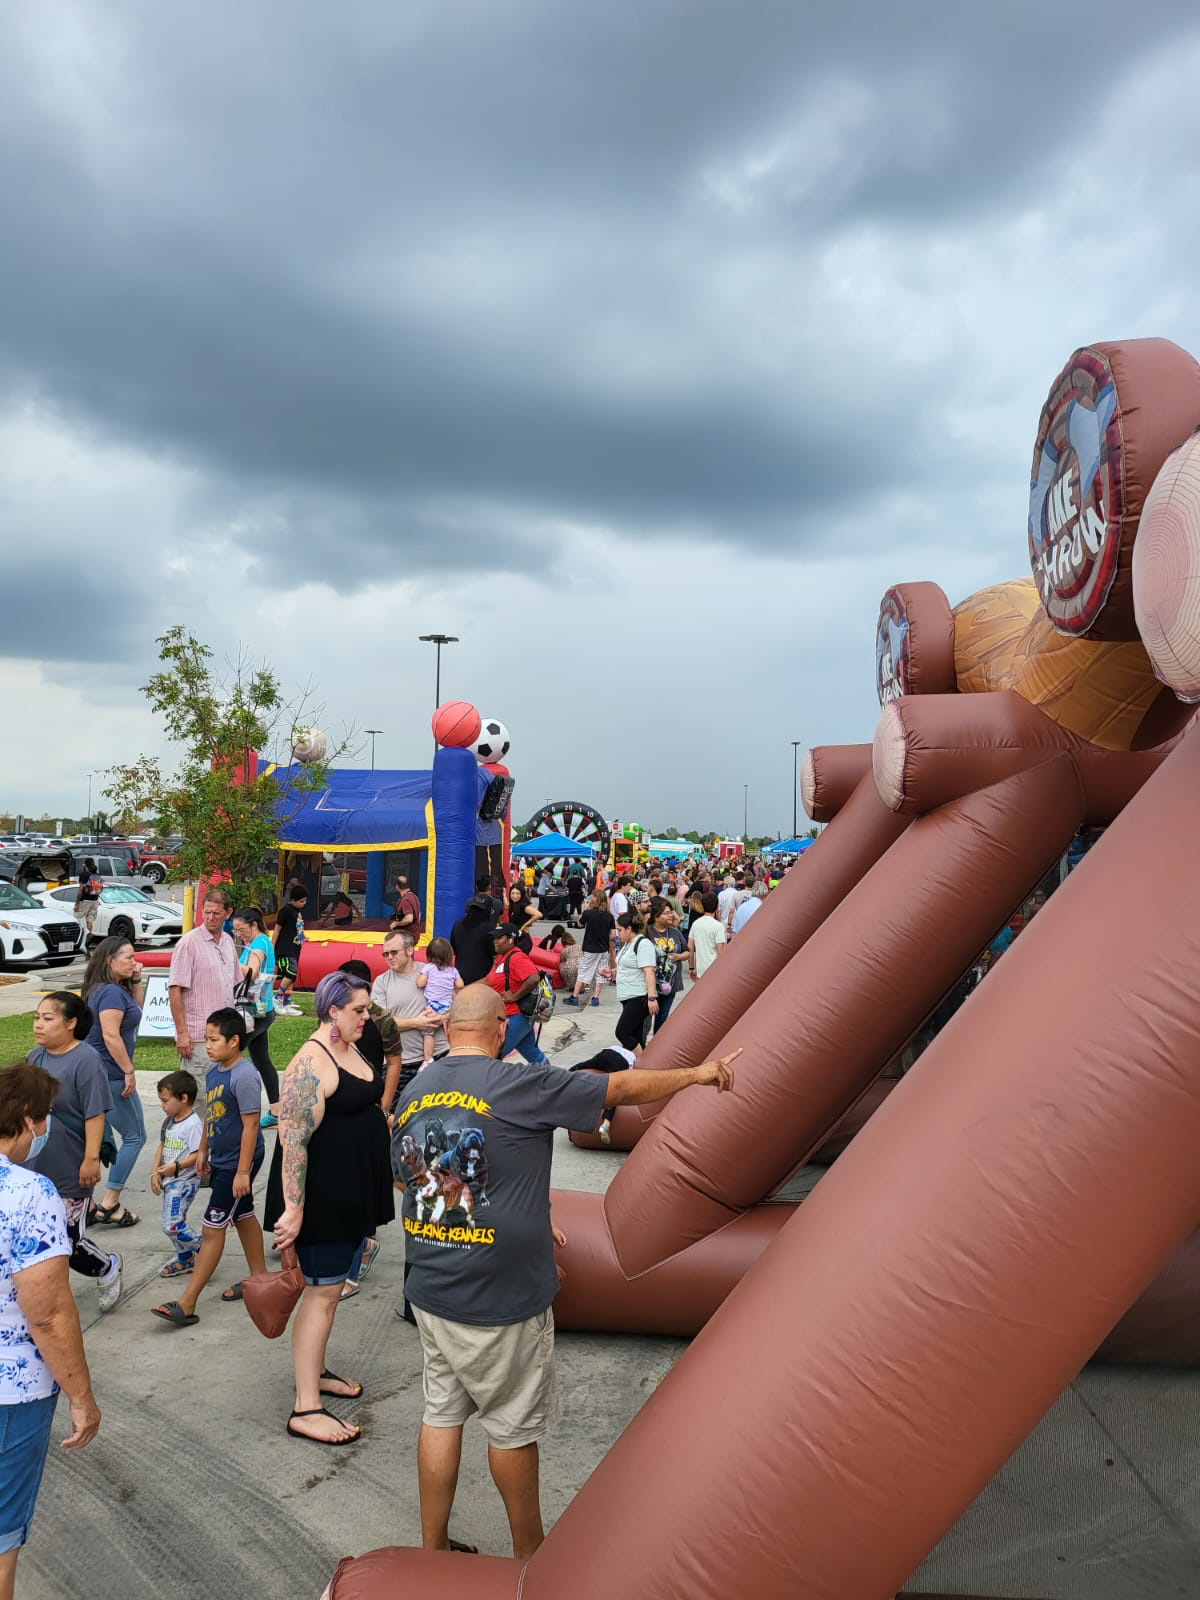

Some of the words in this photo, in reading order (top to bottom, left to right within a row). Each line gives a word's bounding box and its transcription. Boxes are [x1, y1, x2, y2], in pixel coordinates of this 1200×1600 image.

[1036, 500, 1108, 597] THROW
[149, 996, 169, 1007] AM
[418, 1091, 494, 1120] BLOODLINE
[404, 1216, 423, 1236] BLUE
[422, 1222, 447, 1242] KING
[447, 1226, 495, 1244] KENNELS
